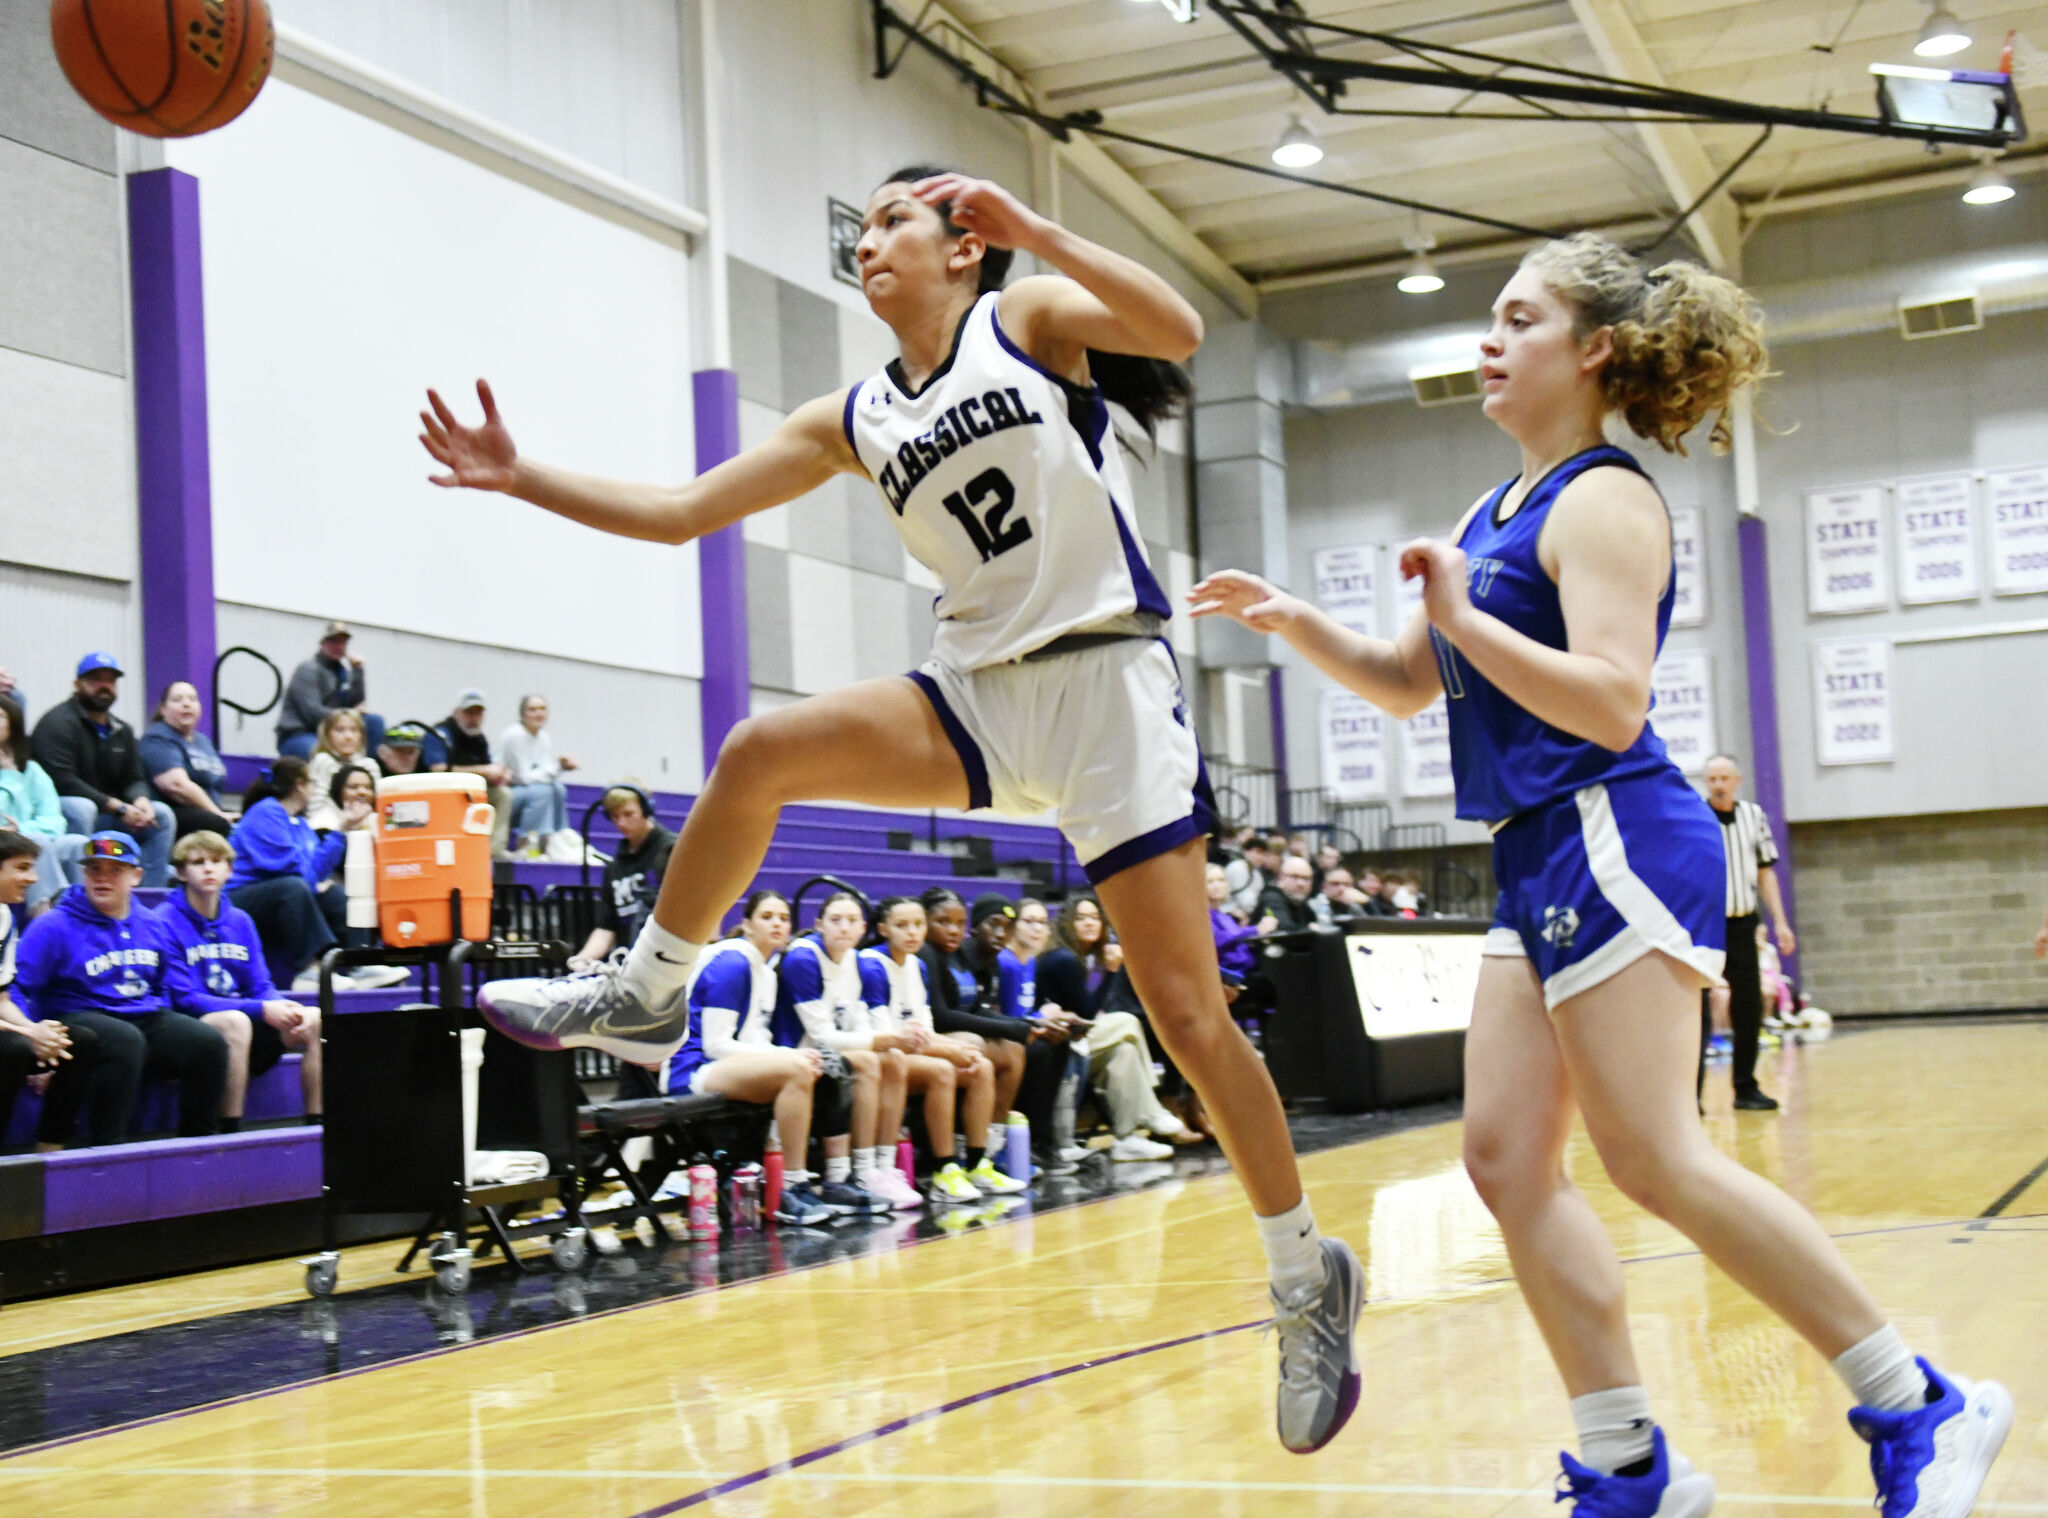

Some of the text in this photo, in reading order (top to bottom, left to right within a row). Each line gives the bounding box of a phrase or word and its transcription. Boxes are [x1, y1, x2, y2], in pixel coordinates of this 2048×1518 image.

[879, 387, 1044, 517] CLASSICAL
[942, 467, 1033, 564] 12
[1906, 508, 1967, 532] STATE
[1817, 519, 1878, 543] STATE
[1318, 574, 1373, 596] STATE
[1825, 671, 1885, 693] STATE
[1656, 686, 1704, 705] TATE
[1330, 716, 1381, 737] STATE
[1409, 711, 1448, 732] STAT
